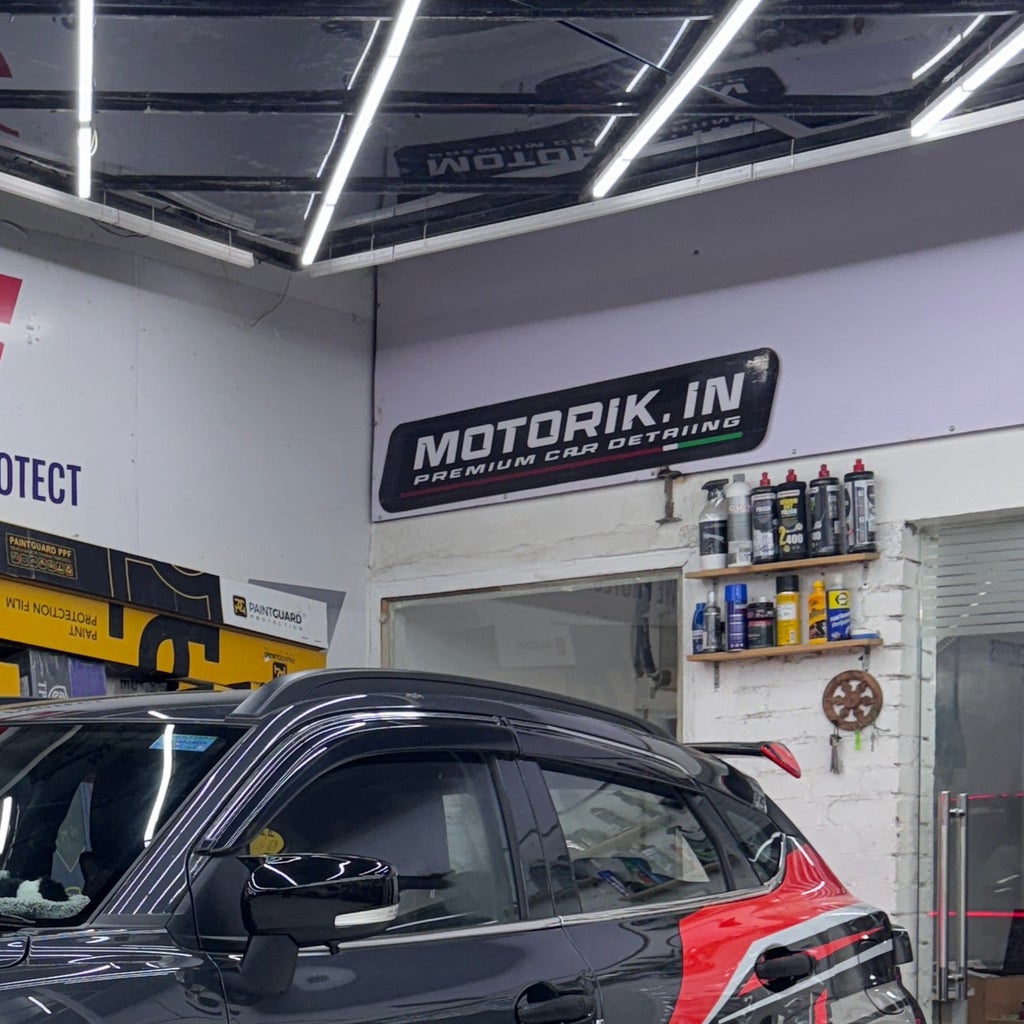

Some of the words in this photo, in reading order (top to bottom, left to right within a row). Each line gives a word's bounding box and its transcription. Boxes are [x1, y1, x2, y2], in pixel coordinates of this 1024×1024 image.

[413, 454, 536, 486] PREMIUM
[544, 442, 598, 463] CAR
[9, 536, 57, 556] PAINTGUARD
[5, 597, 30, 613] FILM
[32, 602, 98, 627] PROTECTION
[249, 602, 303, 624] PAINTGUARD
[68, 626, 97, 640] PAINT
